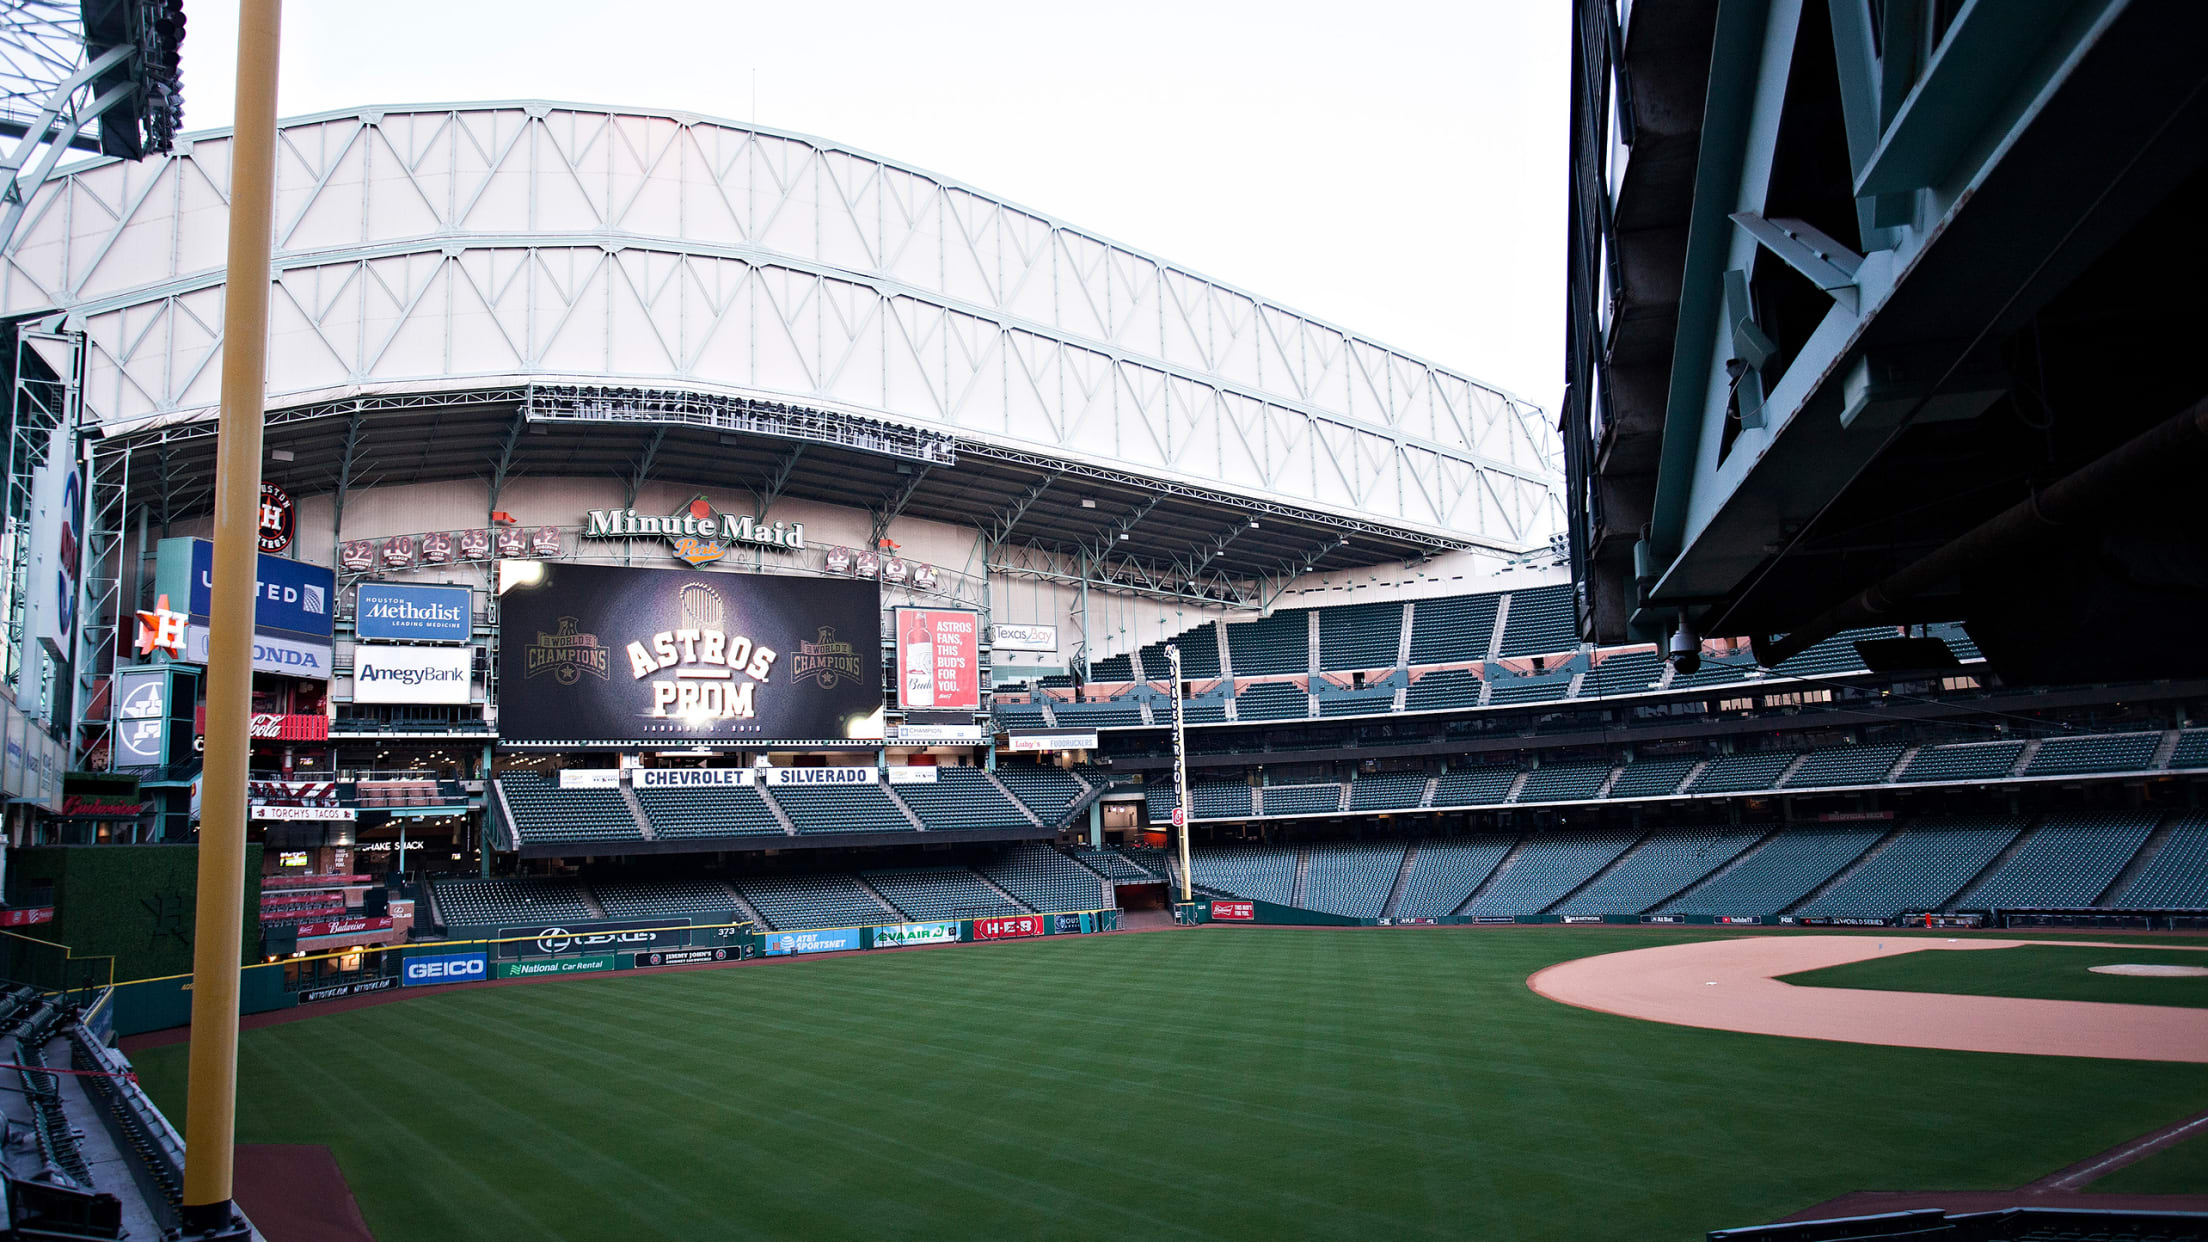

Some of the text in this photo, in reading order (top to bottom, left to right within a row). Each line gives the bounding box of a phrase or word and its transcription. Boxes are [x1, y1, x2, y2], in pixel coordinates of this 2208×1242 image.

[499, 526, 526, 545] 34
[534, 525, 561, 544] 42
[588, 509, 805, 549] Minute Maid
[384, 536, 413, 555] 40
[423, 531, 451, 551] 25
[463, 528, 489, 547] 33
[344, 540, 373, 559] 32
[674, 538, 725, 559] Park
[859, 550, 879, 567] 24
[920, 562, 931, 578] 7
[203, 570, 298, 603] UTED
[365, 602, 461, 620] Methodist
[936, 621, 972, 633] ASTROS
[996, 626, 1053, 643] Texas Bay
[552, 636, 584, 646] WORLD
[937, 633, 963, 645] FANS,
[626, 629, 776, 680] ASTROS
[813, 644, 841, 653] WORLD
[937, 645, 958, 656] THIS
[253, 645, 320, 669] ONDA
[529, 648, 606, 671] CHAMPIONS
[937, 657, 966, 668] BUD'S
[794, 656, 860, 675] CHAMPIONS
[360, 664, 464, 685] AmegyBank
[938, 669, 956, 680] FOR
[938, 681, 960, 692] YOU.
[652, 681, 755, 718] PROM
[1015, 740, 1041, 749] Luby's
[644, 769, 867, 785] CHEVROLET SILVERADO
[272, 808, 339, 818] TORCHYS TACOS
[394, 841, 424, 850] SACK
[328, 921, 366, 934] Budweiser
[1863, 918, 1884, 926] SERIES
[718, 927, 735, 936] 373
[796, 934, 818, 942] AT&T
[878, 930, 931, 942] EVA AIR
[796, 939, 847, 950] SPORTSNET
[408, 959, 484, 978] GEICO
[521, 961, 603, 974] National Car Rental
